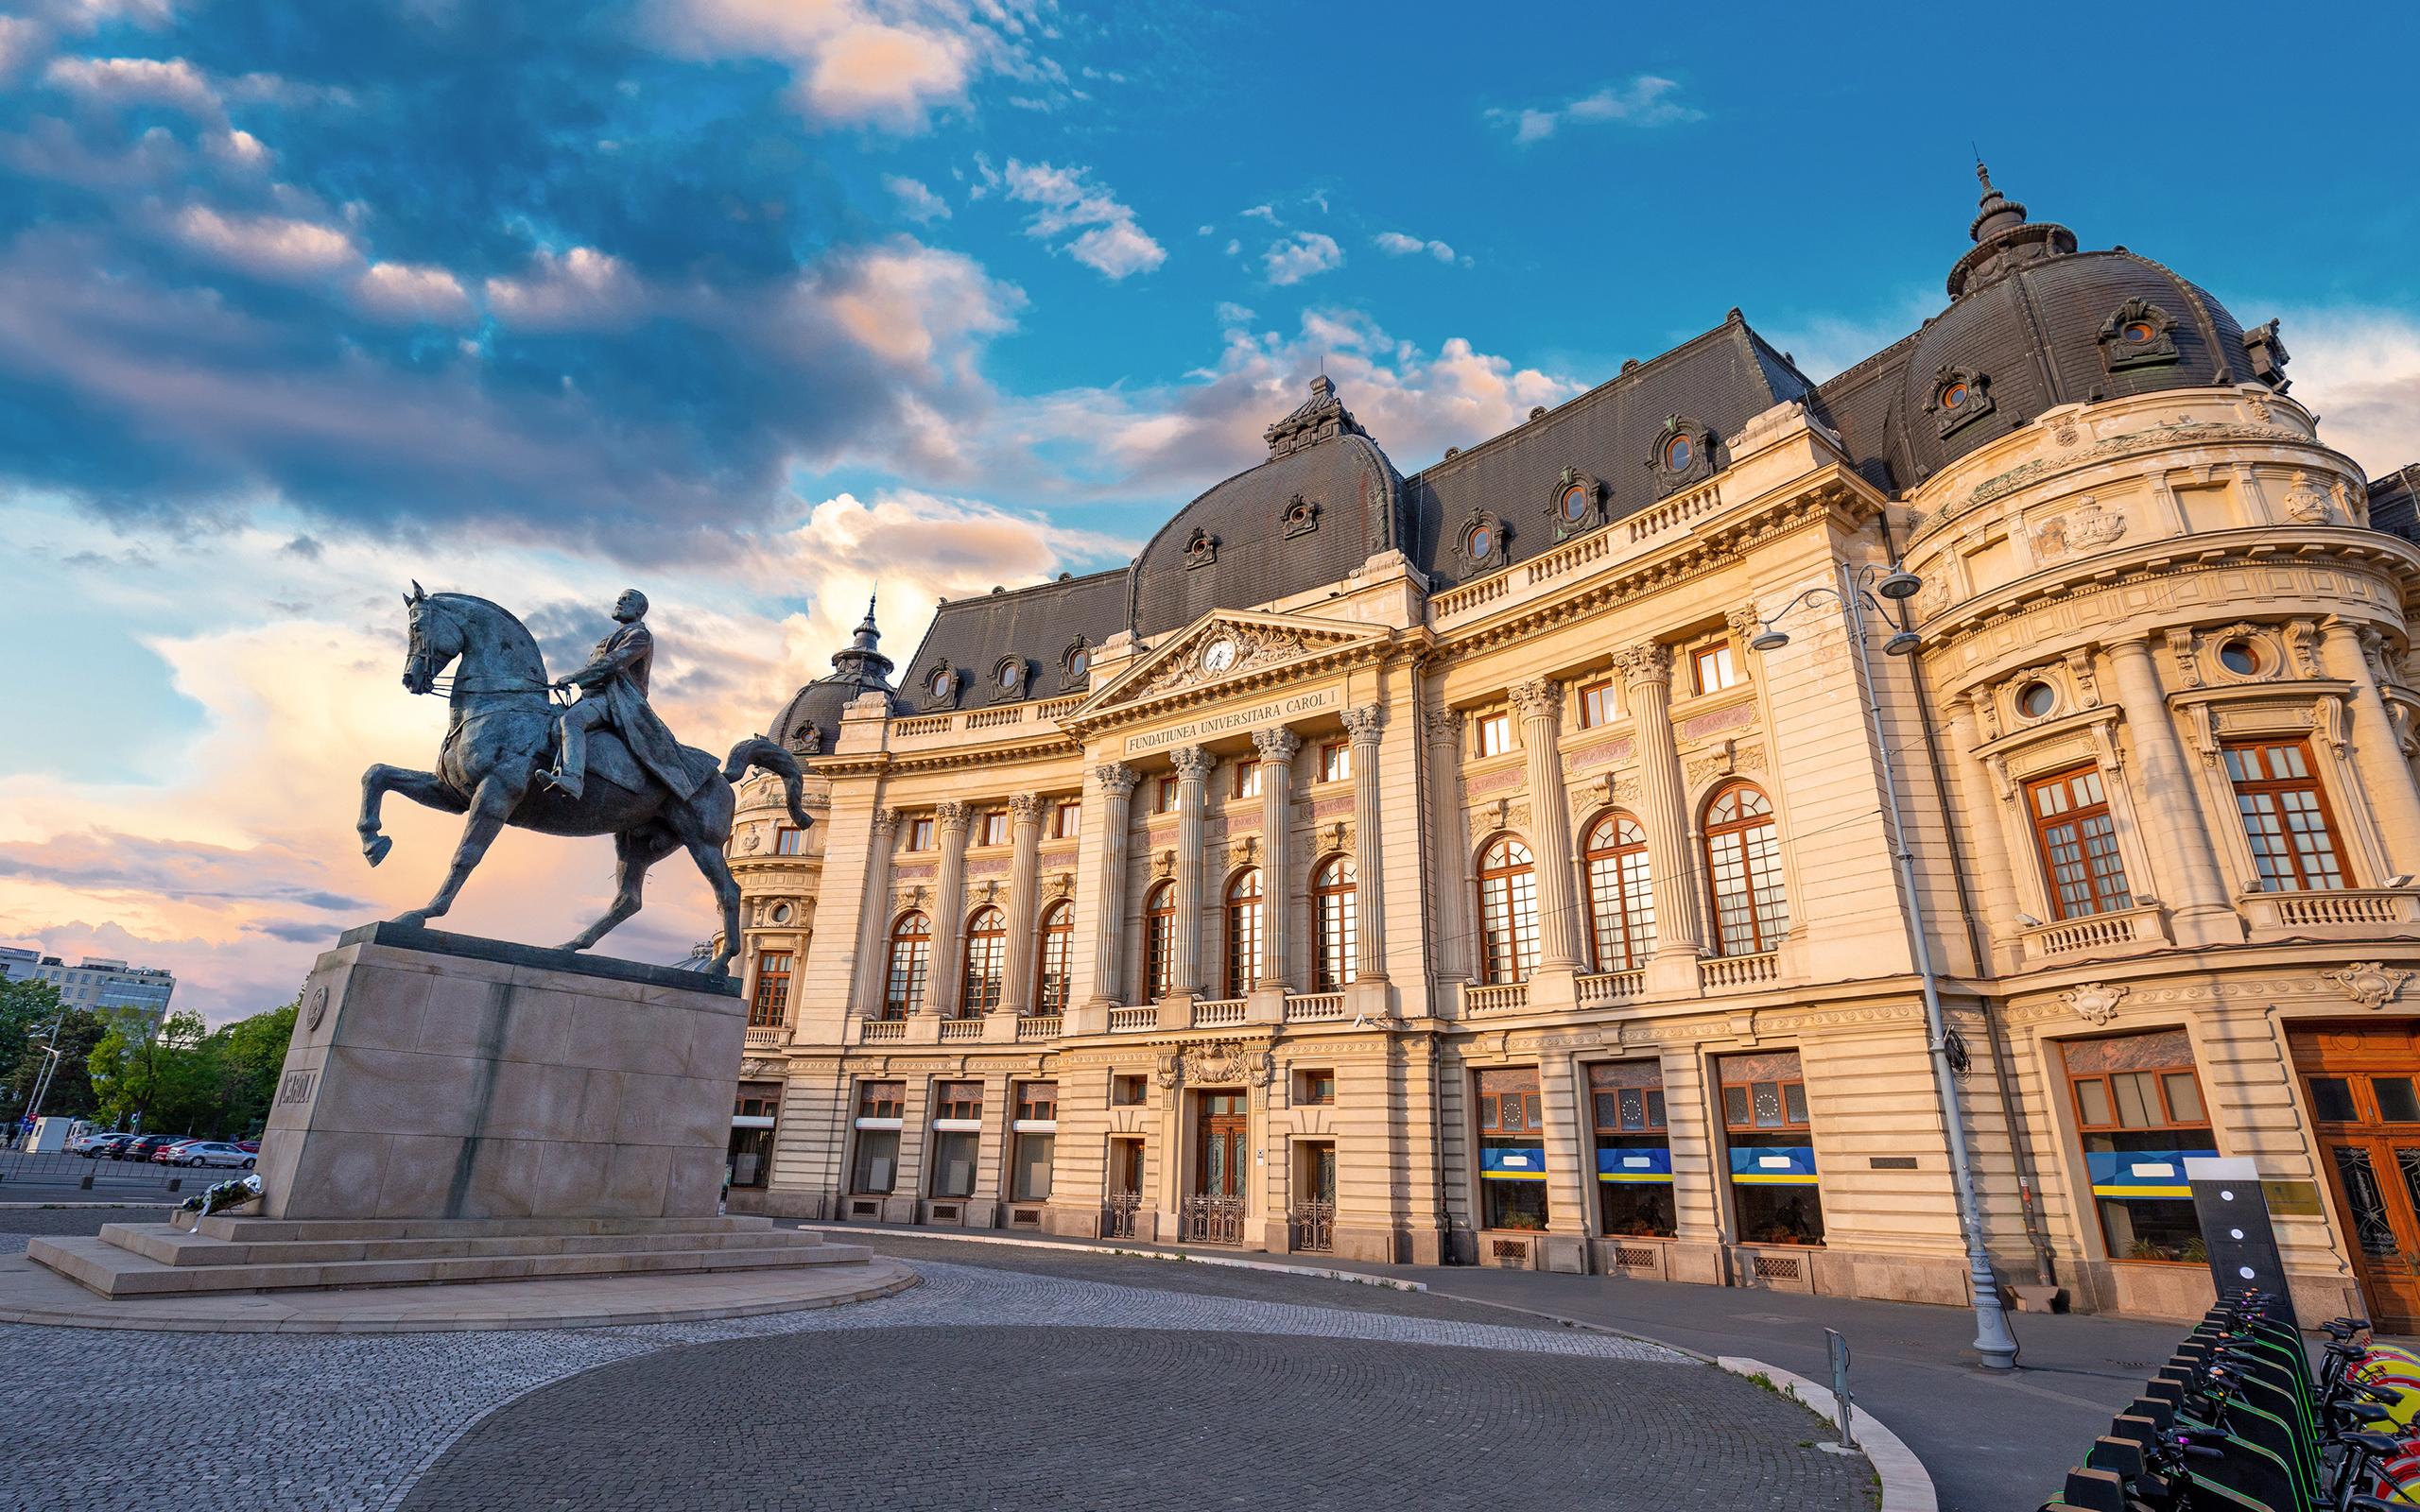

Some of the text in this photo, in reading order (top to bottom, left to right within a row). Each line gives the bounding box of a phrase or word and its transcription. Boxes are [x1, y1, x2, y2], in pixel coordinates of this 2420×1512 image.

[1130, 690, 1337, 750] FUNDATIUNEA UNIVERSITARA CAROL I
[283, 1074, 311, 1104] CAROL
